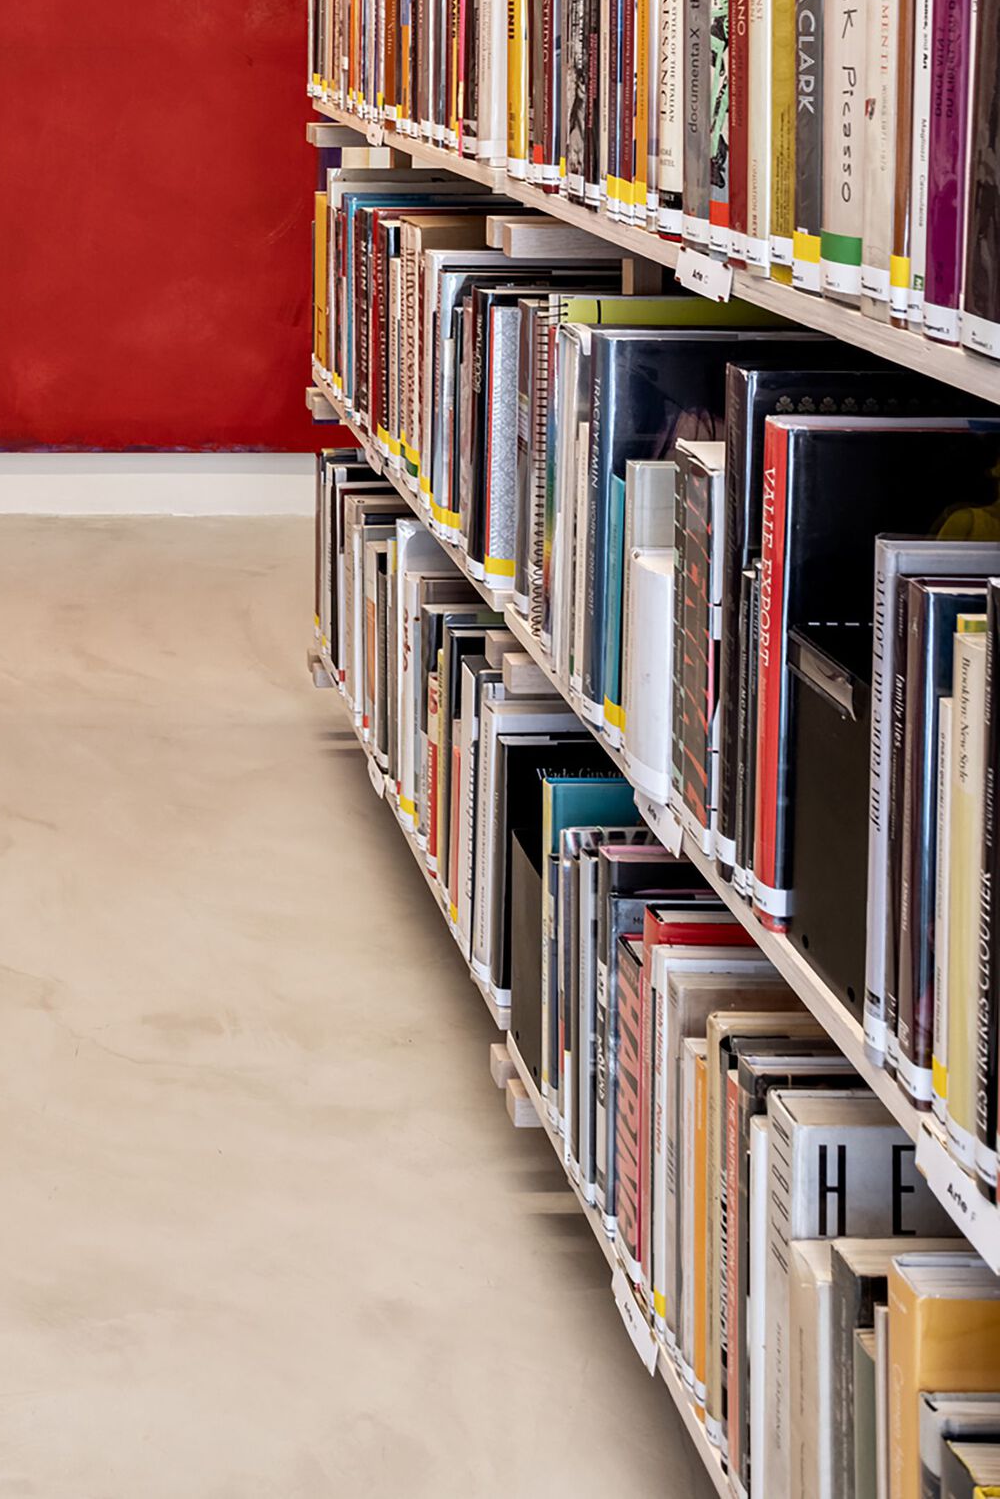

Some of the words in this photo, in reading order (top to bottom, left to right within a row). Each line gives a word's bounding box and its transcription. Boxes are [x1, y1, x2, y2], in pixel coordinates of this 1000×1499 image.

[670, 6, 679, 38] STYLES
[797, 9, 815, 115] CLARK
[668, 83, 677, 123] ITALIAN
[687, 42, 700, 134] documenta
[841, 65, 858, 203] Picasso
[376, 253, 388, 323] marcel
[380, 330, 389, 430] duchamp
[591, 376, 602, 443] TRACEY
[590, 444, 600, 488] EMIN
[589, 501, 597, 544] WORKS
[763, 466, 776, 549] VALIE
[740, 614, 748, 651] Amazing
[760, 557, 774, 667] EXPORT
[873, 570, 888, 662] Louvre
[740, 653, 748, 677] World
[957, 655, 972, 720] Brooklyn:
[892, 673, 906, 718] family
[983, 685, 992, 726] Patrick
[893, 721, 904, 749] ties
[958, 722, 970, 750] New
[957, 751, 970, 783] Style
[869, 788, 882, 834] Jan
[985, 767, 995, 830] SCULPTEURS
[978, 868, 992, 992] CLOUTIER
[655, 991, 665, 1028] Keith
[654, 1030, 664, 1076] Haring
[616, 975, 641, 1239] HARING
[654, 1102, 664, 1156] Posters
[976, 1089, 989, 1132] LES
[771, 1115, 790, 1275] HERBIN
[946, 1182, 968, 1214] Arte
